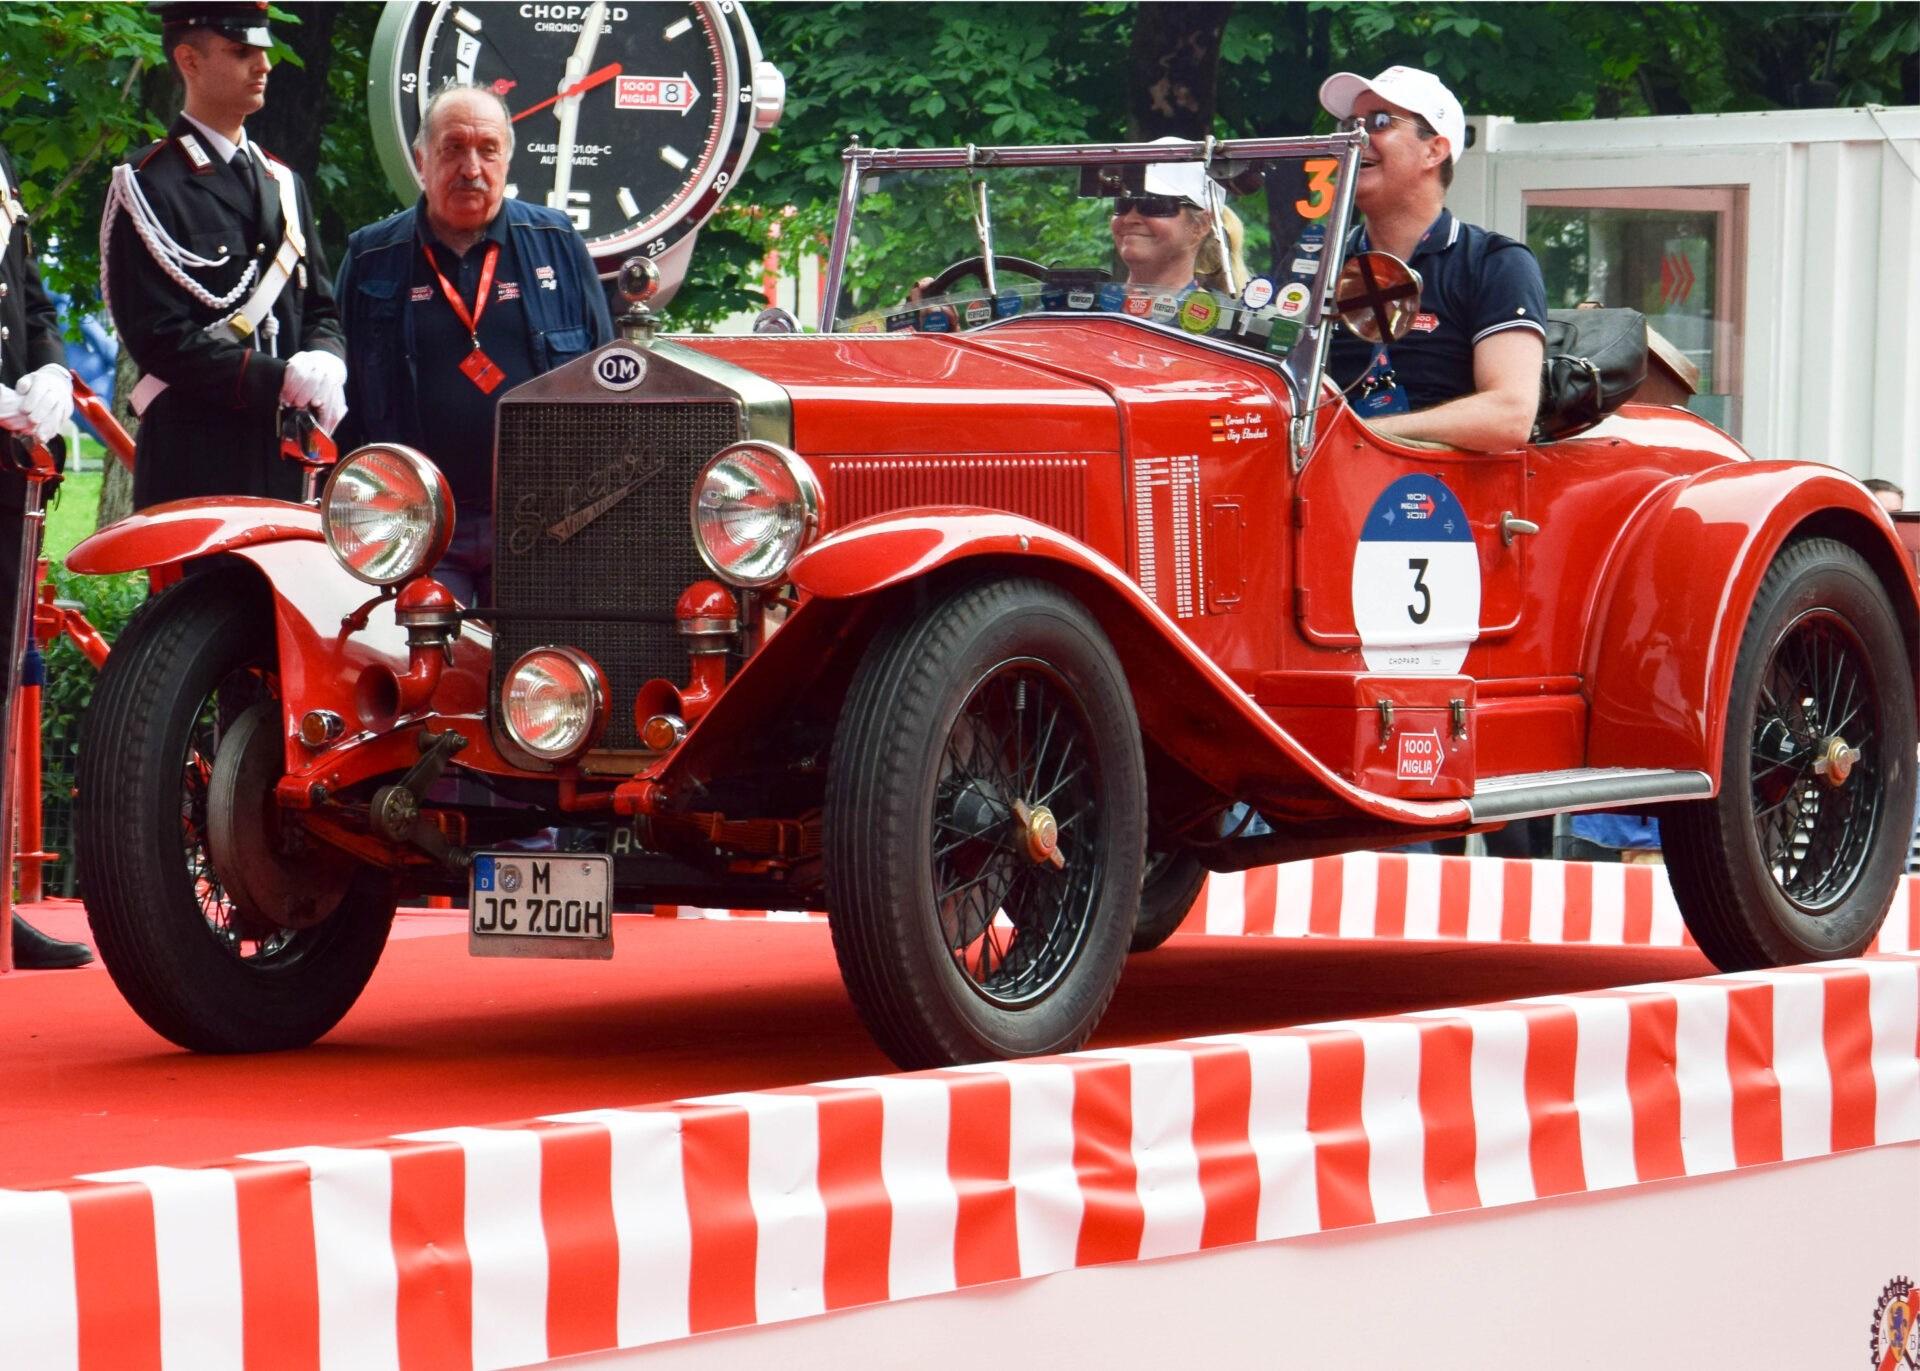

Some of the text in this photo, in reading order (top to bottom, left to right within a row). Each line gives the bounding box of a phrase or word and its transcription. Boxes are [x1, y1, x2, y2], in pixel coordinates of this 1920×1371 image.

[535, 22, 612, 34] CHRONOER
[402, 72, 417, 94] 45
[622, 81, 655, 91] 1000
[620, 94, 657, 104] MIGLIA
[665, 83, 679, 103] 8
[740, 85, 752, 103] 15
[527, 143, 559, 153] CALIB
[540, 156, 598, 166] AUMATIC
[712, 172, 730, 194] 20
[1295, 158, 1339, 219] 3
[647, 238, 666, 256] 25
[603, 359, 636, 380] OM
[1407, 558, 1431, 625] 3
[1405, 740, 1432, 754] 1000
[1401, 760, 1432, 774] MIGLIA
[481, 877, 489, 889] D
[532, 862, 550, 894] M
[480, 898, 517, 931] JC
